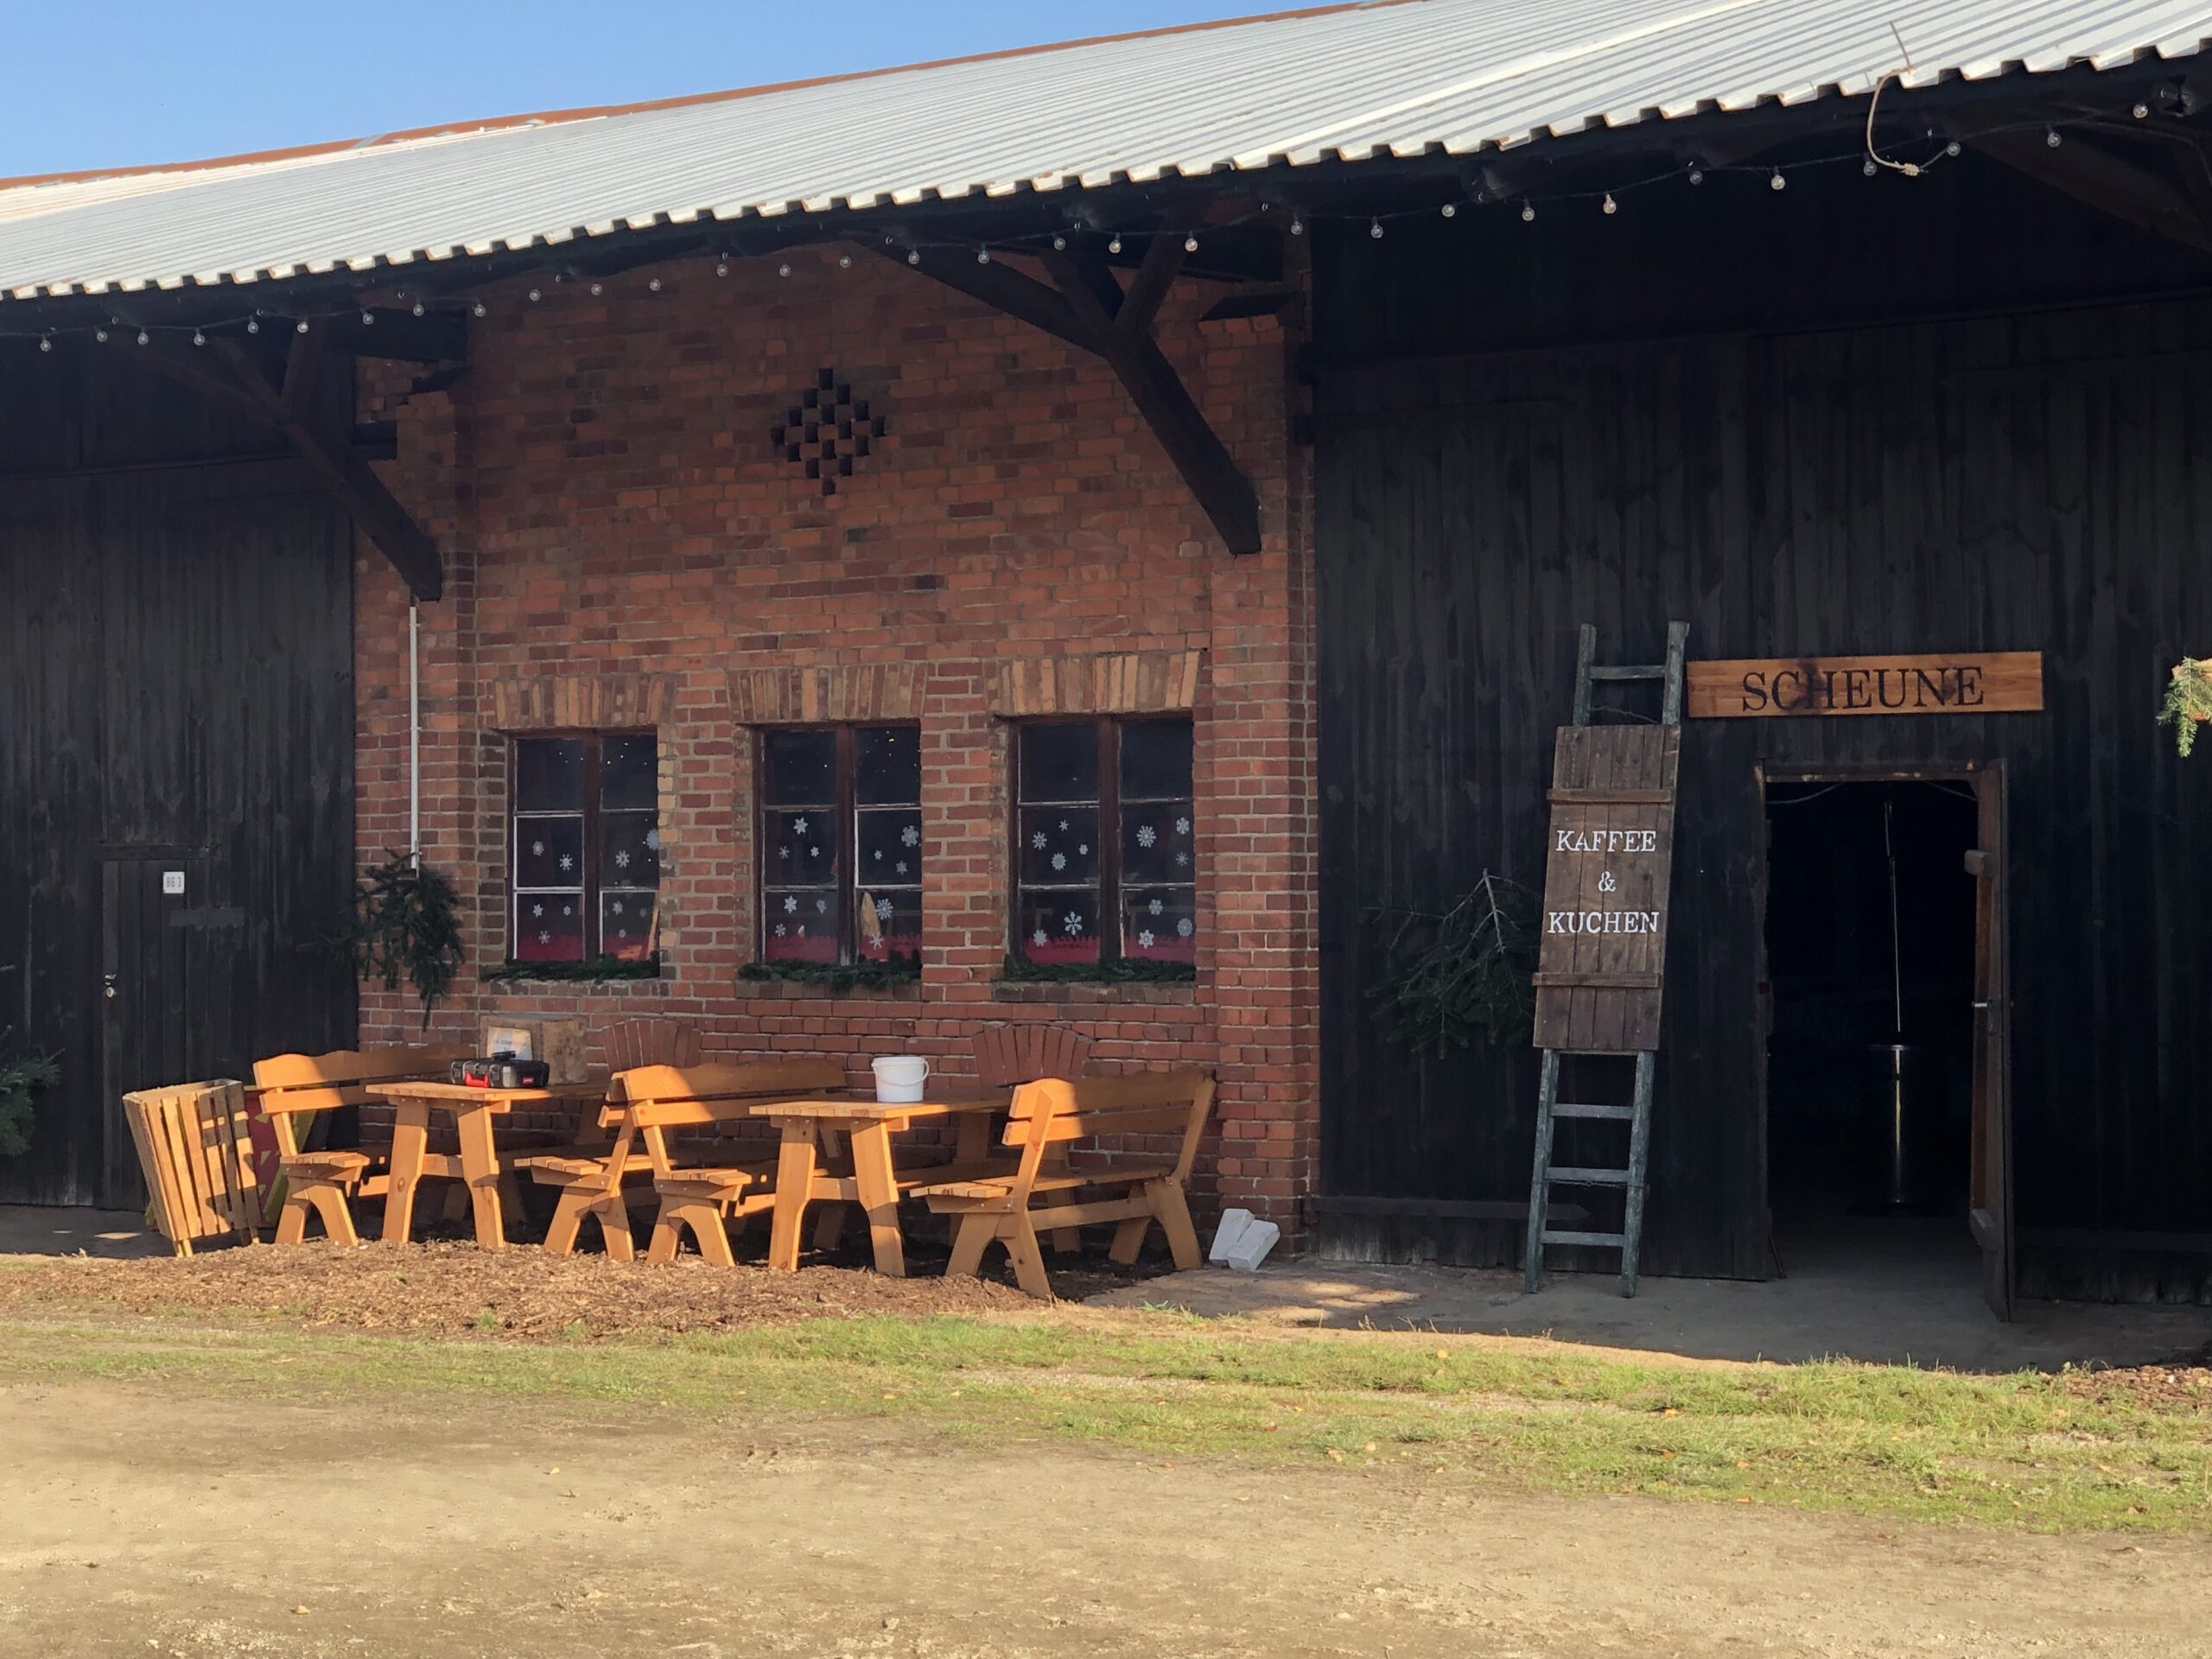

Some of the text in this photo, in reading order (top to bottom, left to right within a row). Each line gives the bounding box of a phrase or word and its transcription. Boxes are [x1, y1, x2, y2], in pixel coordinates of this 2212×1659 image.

[1742, 666, 1984, 712] SCHEUNE
[1555, 830, 1656, 852] KAFFEE
[1598, 871, 1616, 893] &
[1548, 912, 1659, 934] KUCHEN
